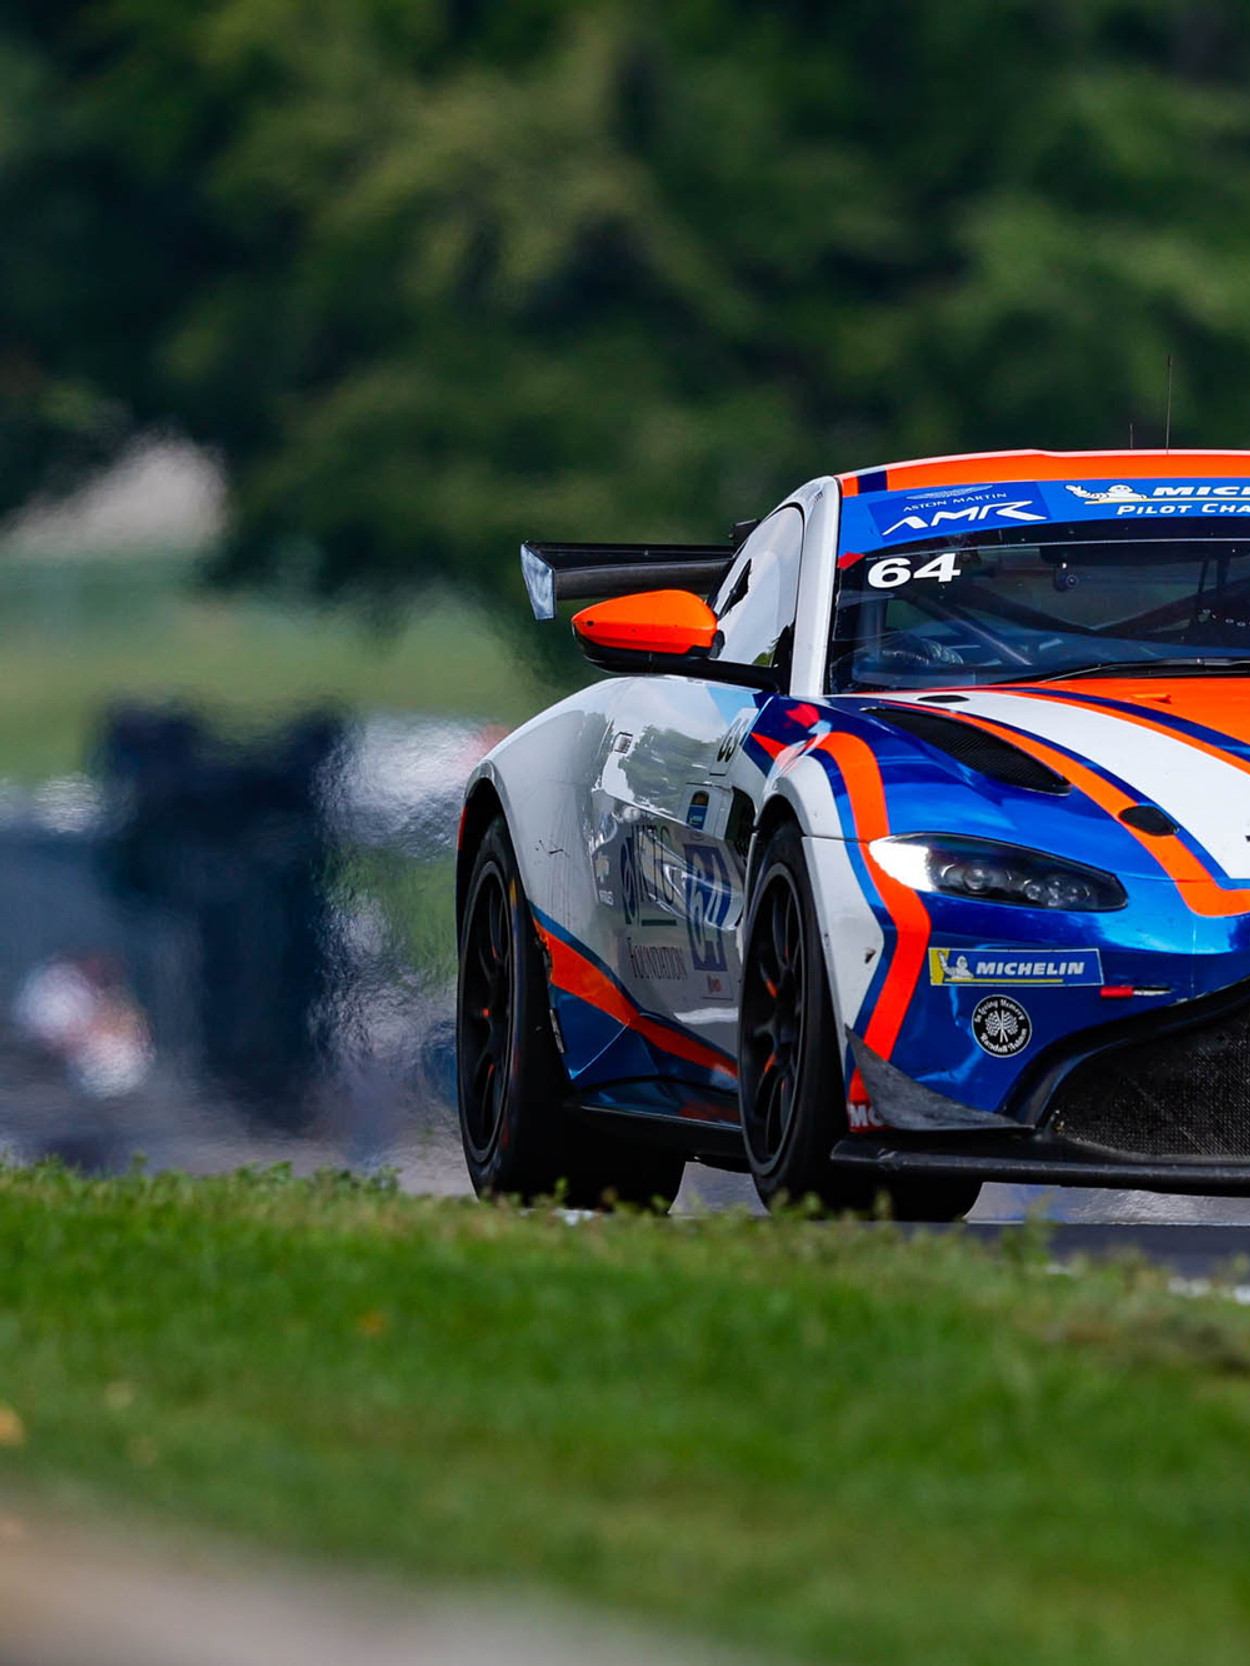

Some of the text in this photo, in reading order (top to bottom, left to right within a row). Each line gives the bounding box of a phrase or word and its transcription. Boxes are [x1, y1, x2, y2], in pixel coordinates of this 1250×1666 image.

[903, 492, 1007, 512] ASTON MARTIN
[1117, 503, 1192, 516] PILOT
[882, 500, 1048, 537] AMR
[867, 553, 961, 589] 64
[975, 961, 1085, 976] MICHELIN
